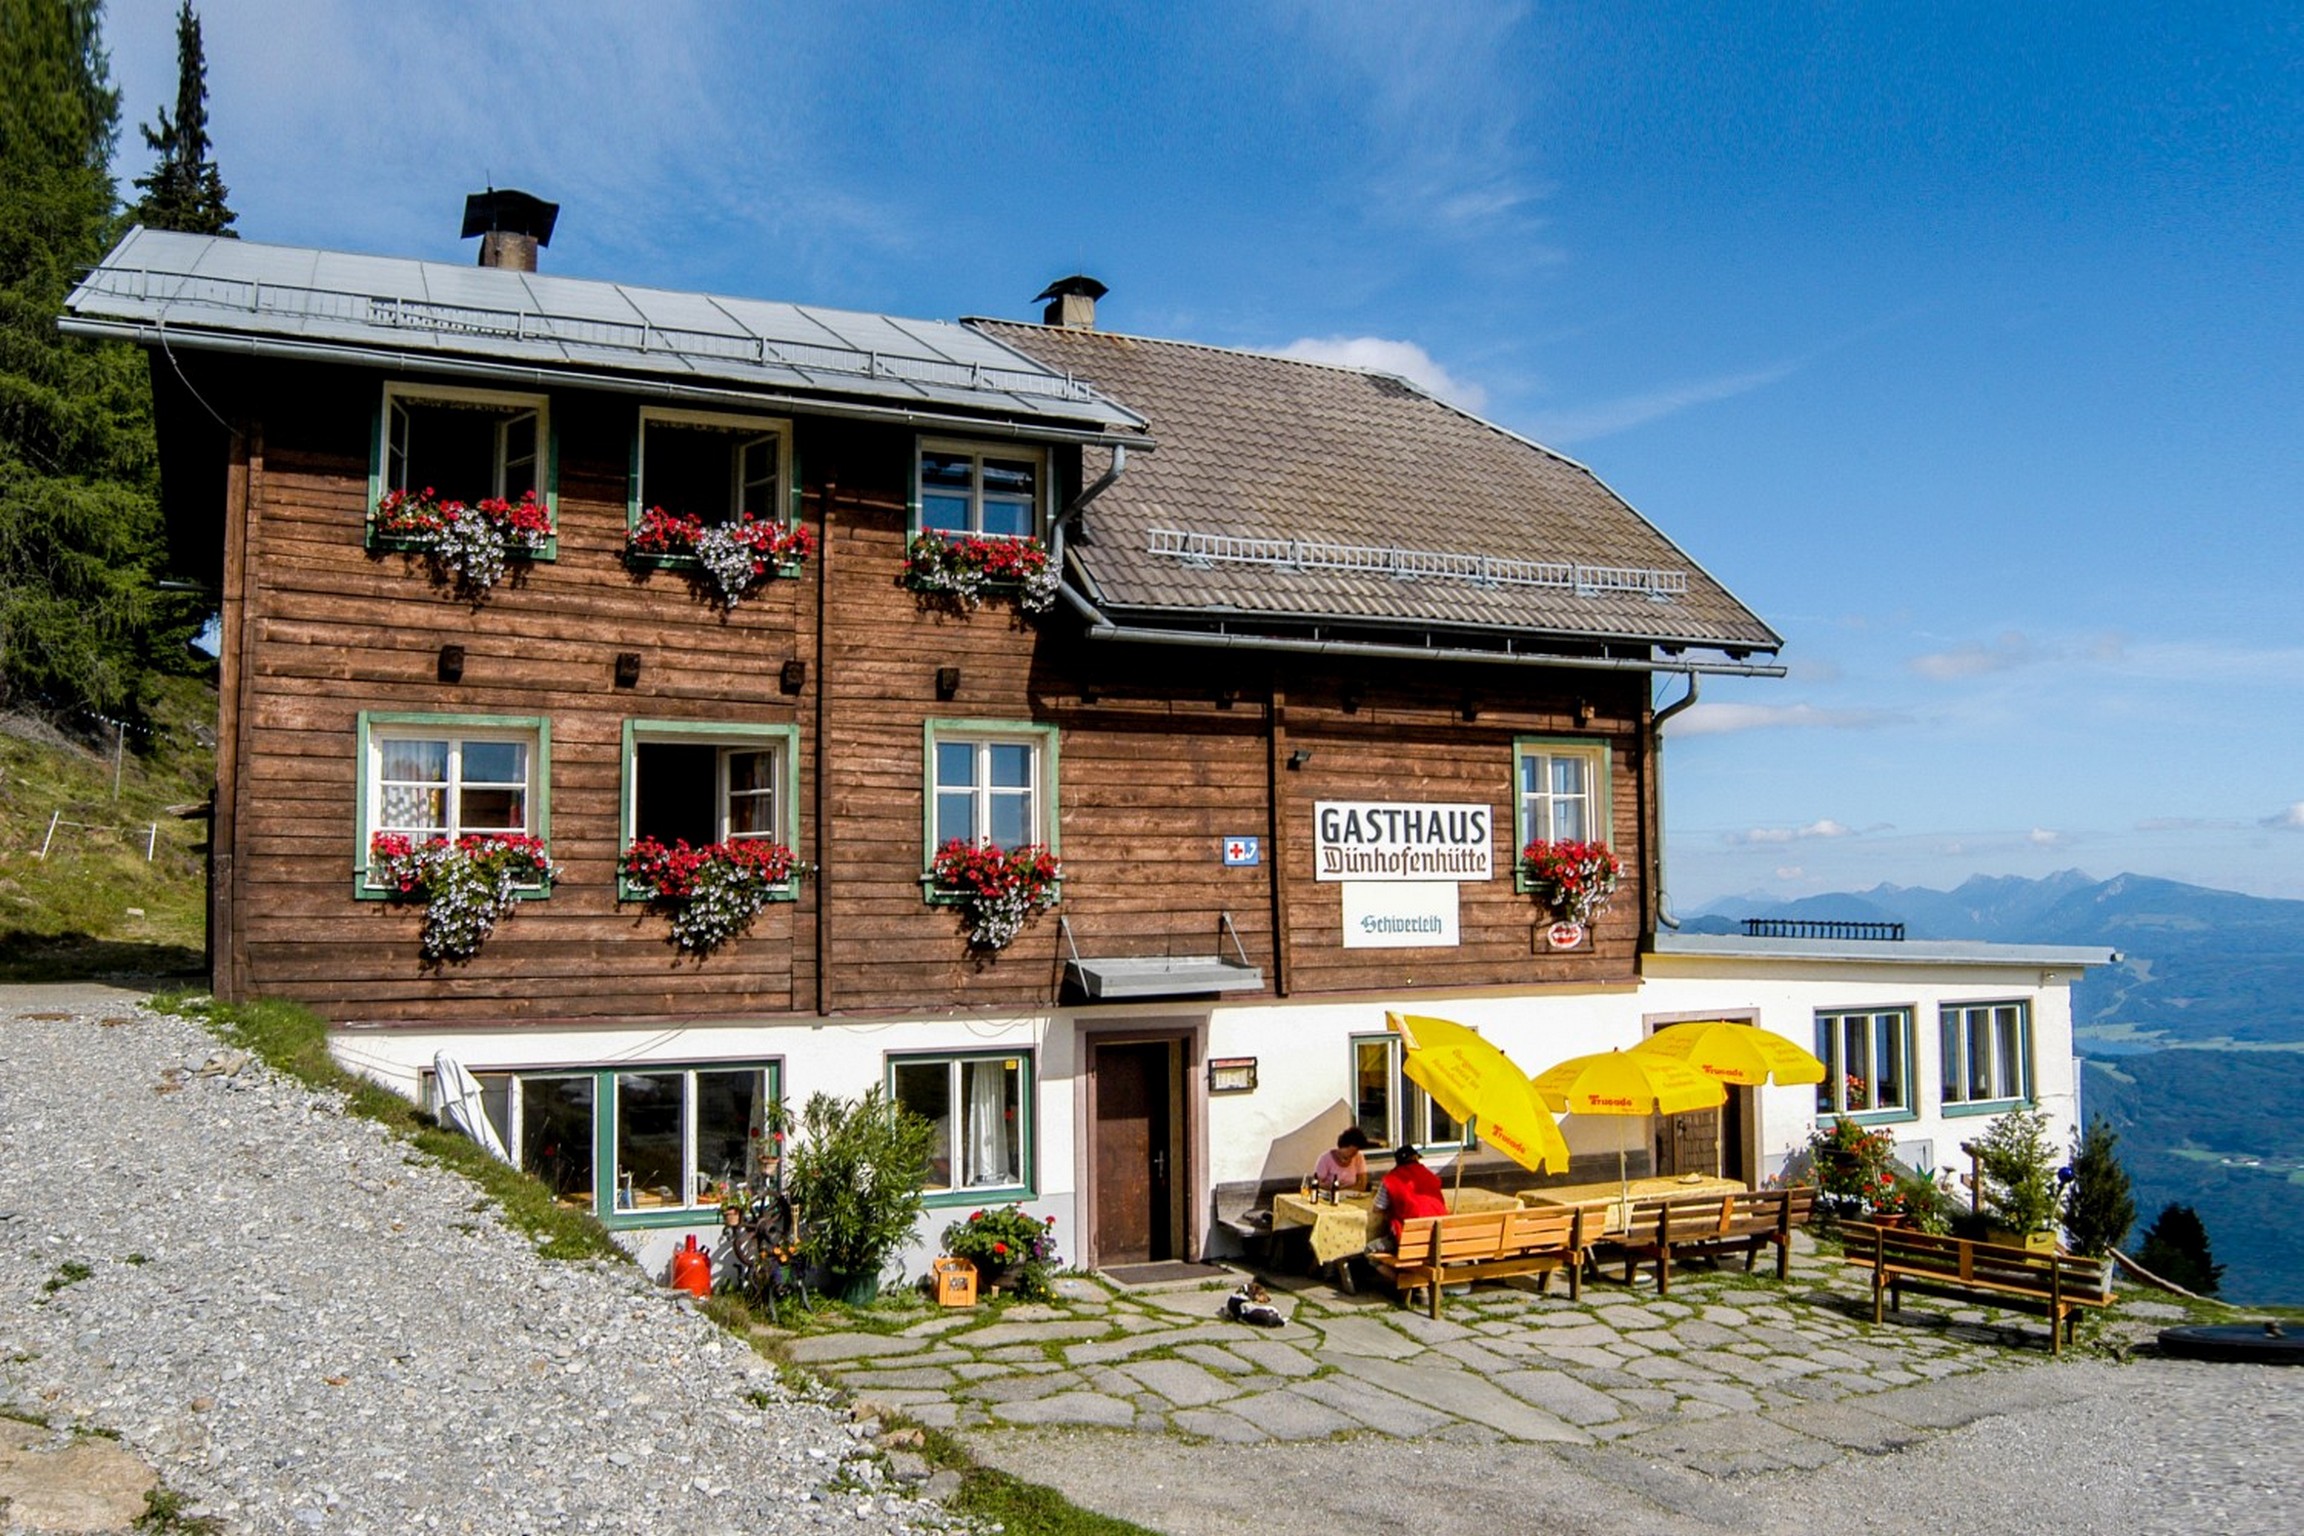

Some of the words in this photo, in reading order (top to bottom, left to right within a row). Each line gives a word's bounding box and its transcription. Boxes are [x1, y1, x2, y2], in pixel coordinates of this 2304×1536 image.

[1321, 808, 1486, 844] GASTHAUS
[1323, 846, 1487, 876] Dünhofenhütte
[1360, 914, 1442, 935] Schiverleih
